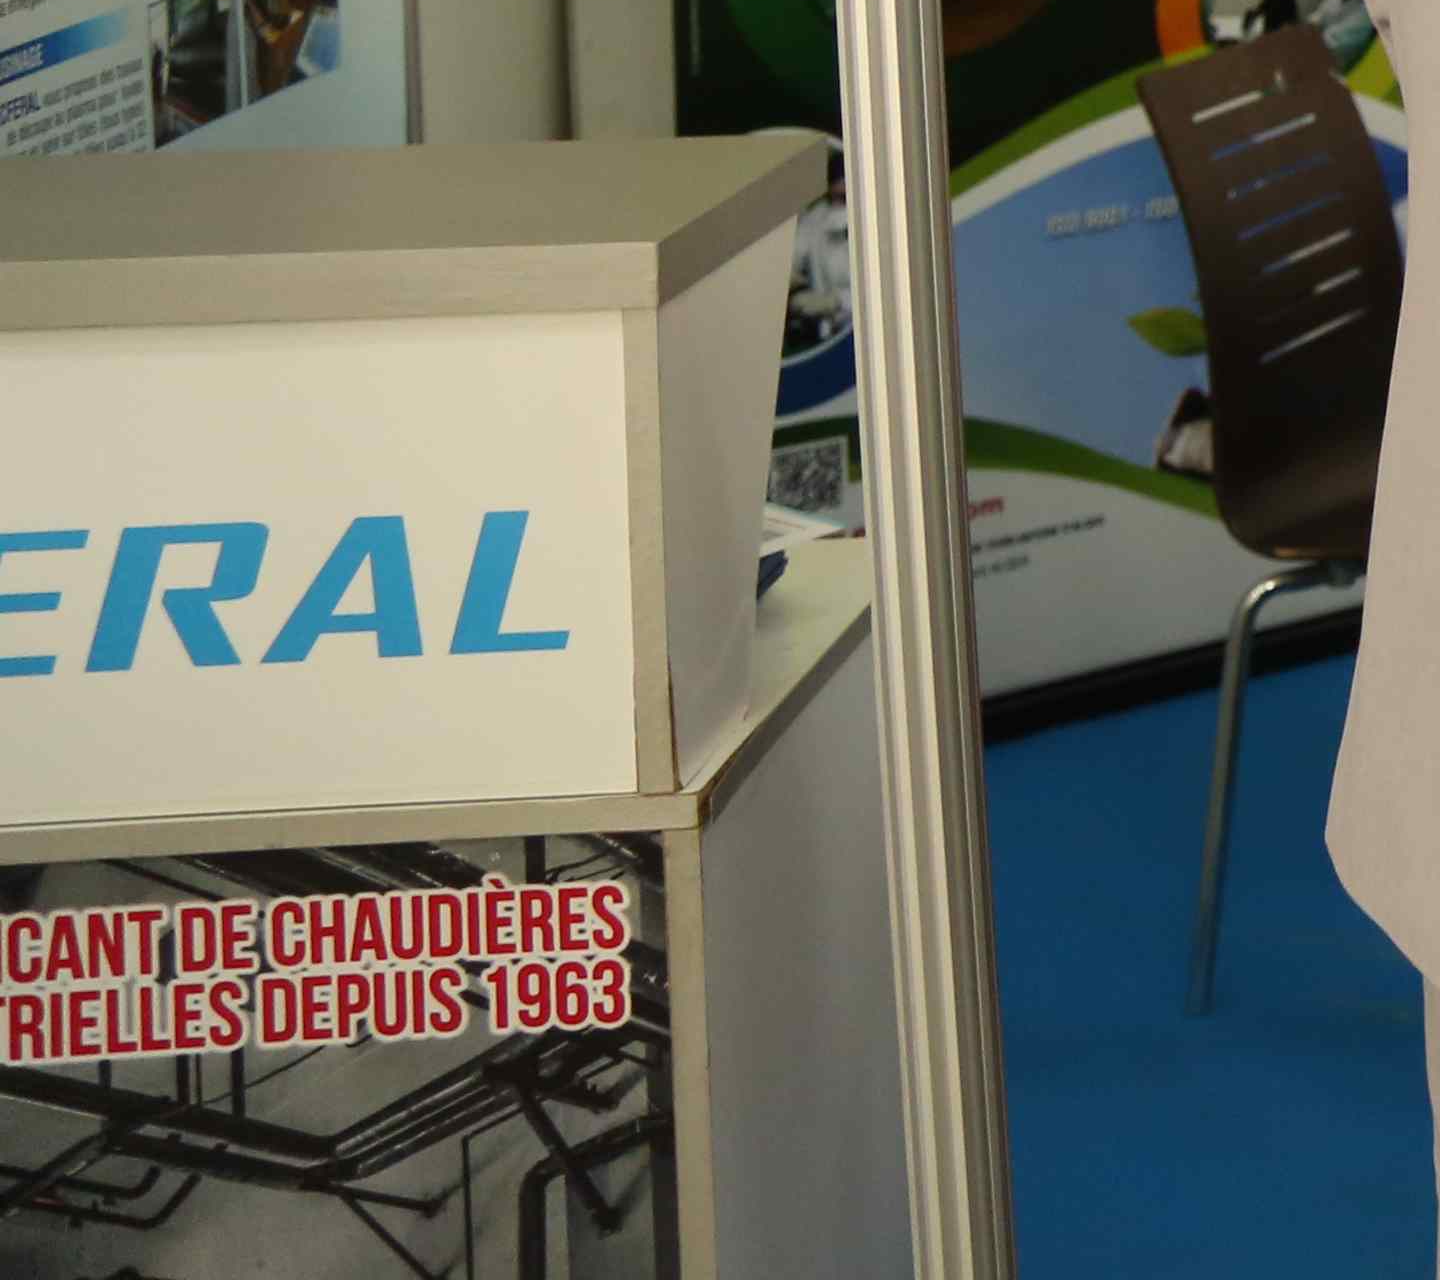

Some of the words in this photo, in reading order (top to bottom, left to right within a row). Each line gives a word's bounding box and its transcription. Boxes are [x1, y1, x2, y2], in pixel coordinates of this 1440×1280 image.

[0, 909, 163, 985] CANT
[180, 905, 254, 973] DE
[271, 878, 626, 966] CHAUDIÈRES
[0, 981, 244, 1062] RIELLES
[262, 970, 462, 1044] DEPUIS
[486, 960, 628, 1031] 1963
